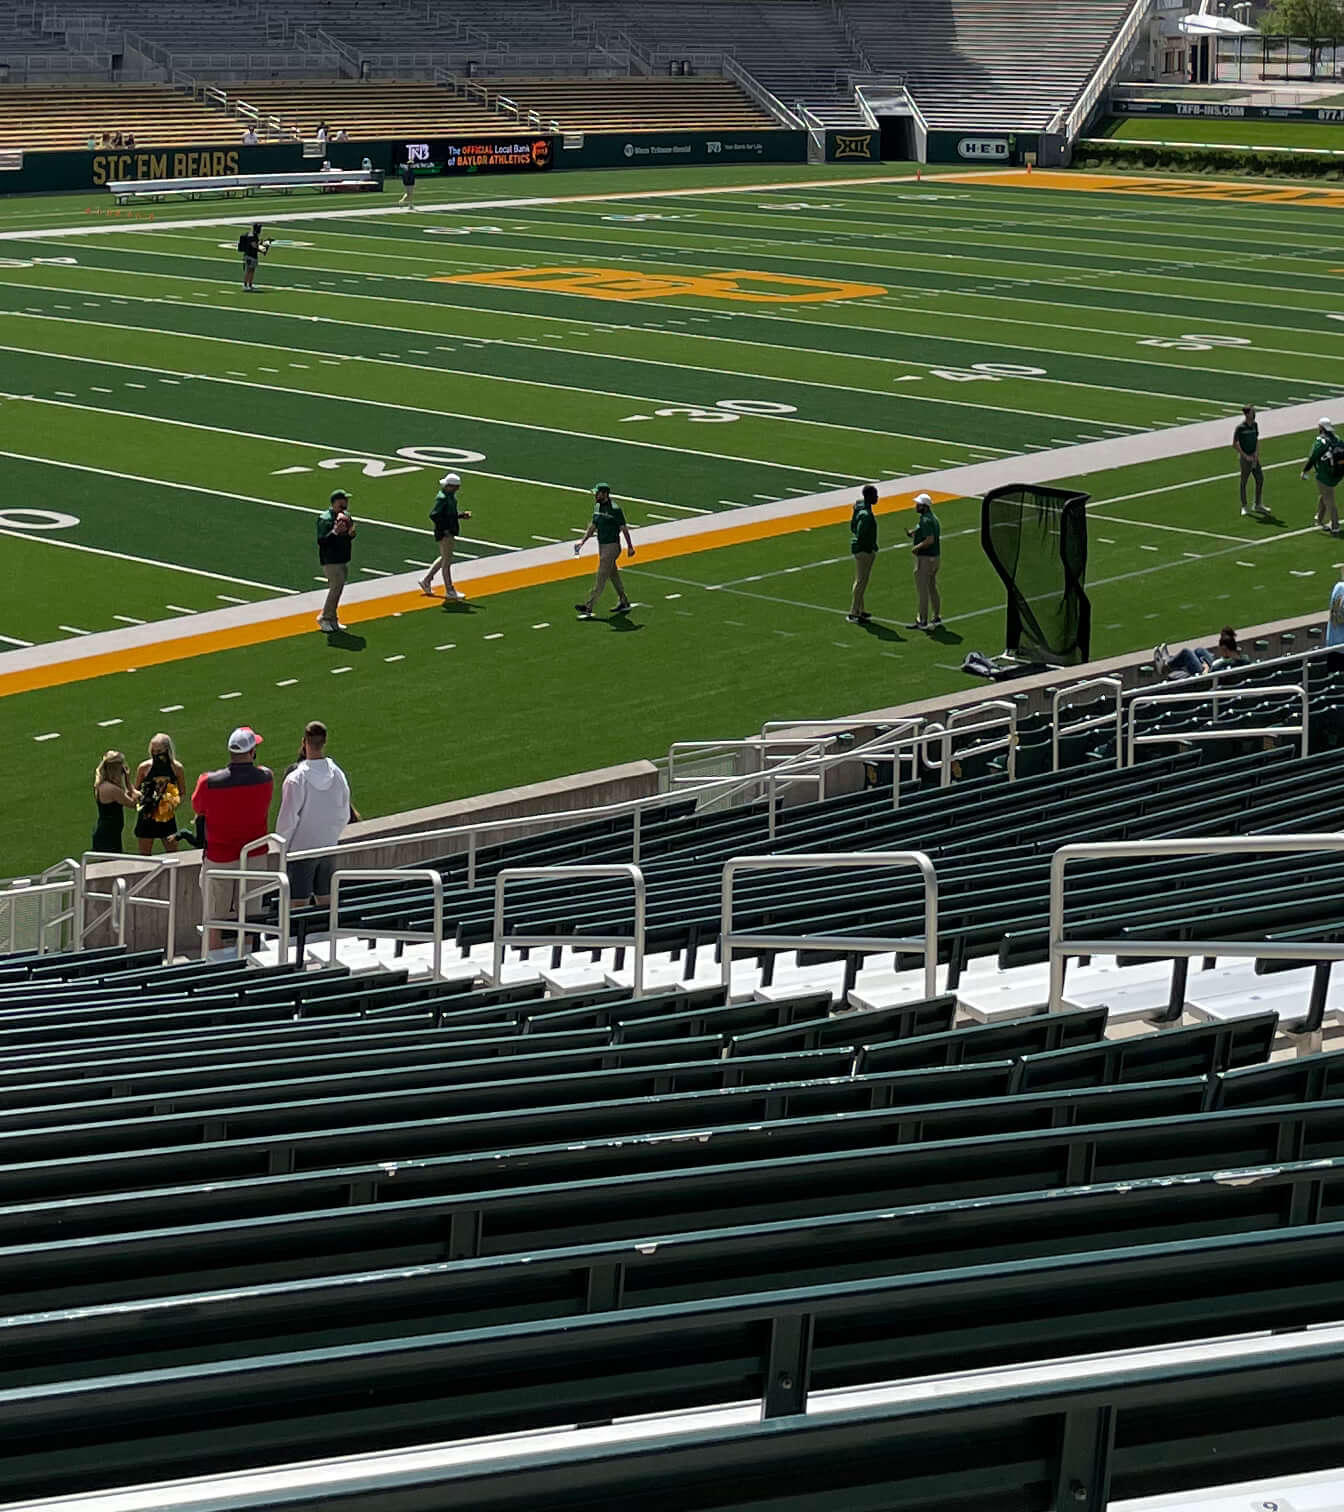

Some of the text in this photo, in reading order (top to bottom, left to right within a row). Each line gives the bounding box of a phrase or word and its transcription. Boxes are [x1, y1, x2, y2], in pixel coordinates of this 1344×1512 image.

[448, 143, 531, 155] The OFFICIAL Local Bank
[457, 155, 488, 167] BAYLOR
[489, 153, 531, 166] ATHLETICS
[174, 151, 240, 177] BEARS
[653, 399, 799, 423] 30
[316, 445, 487, 478] 20
